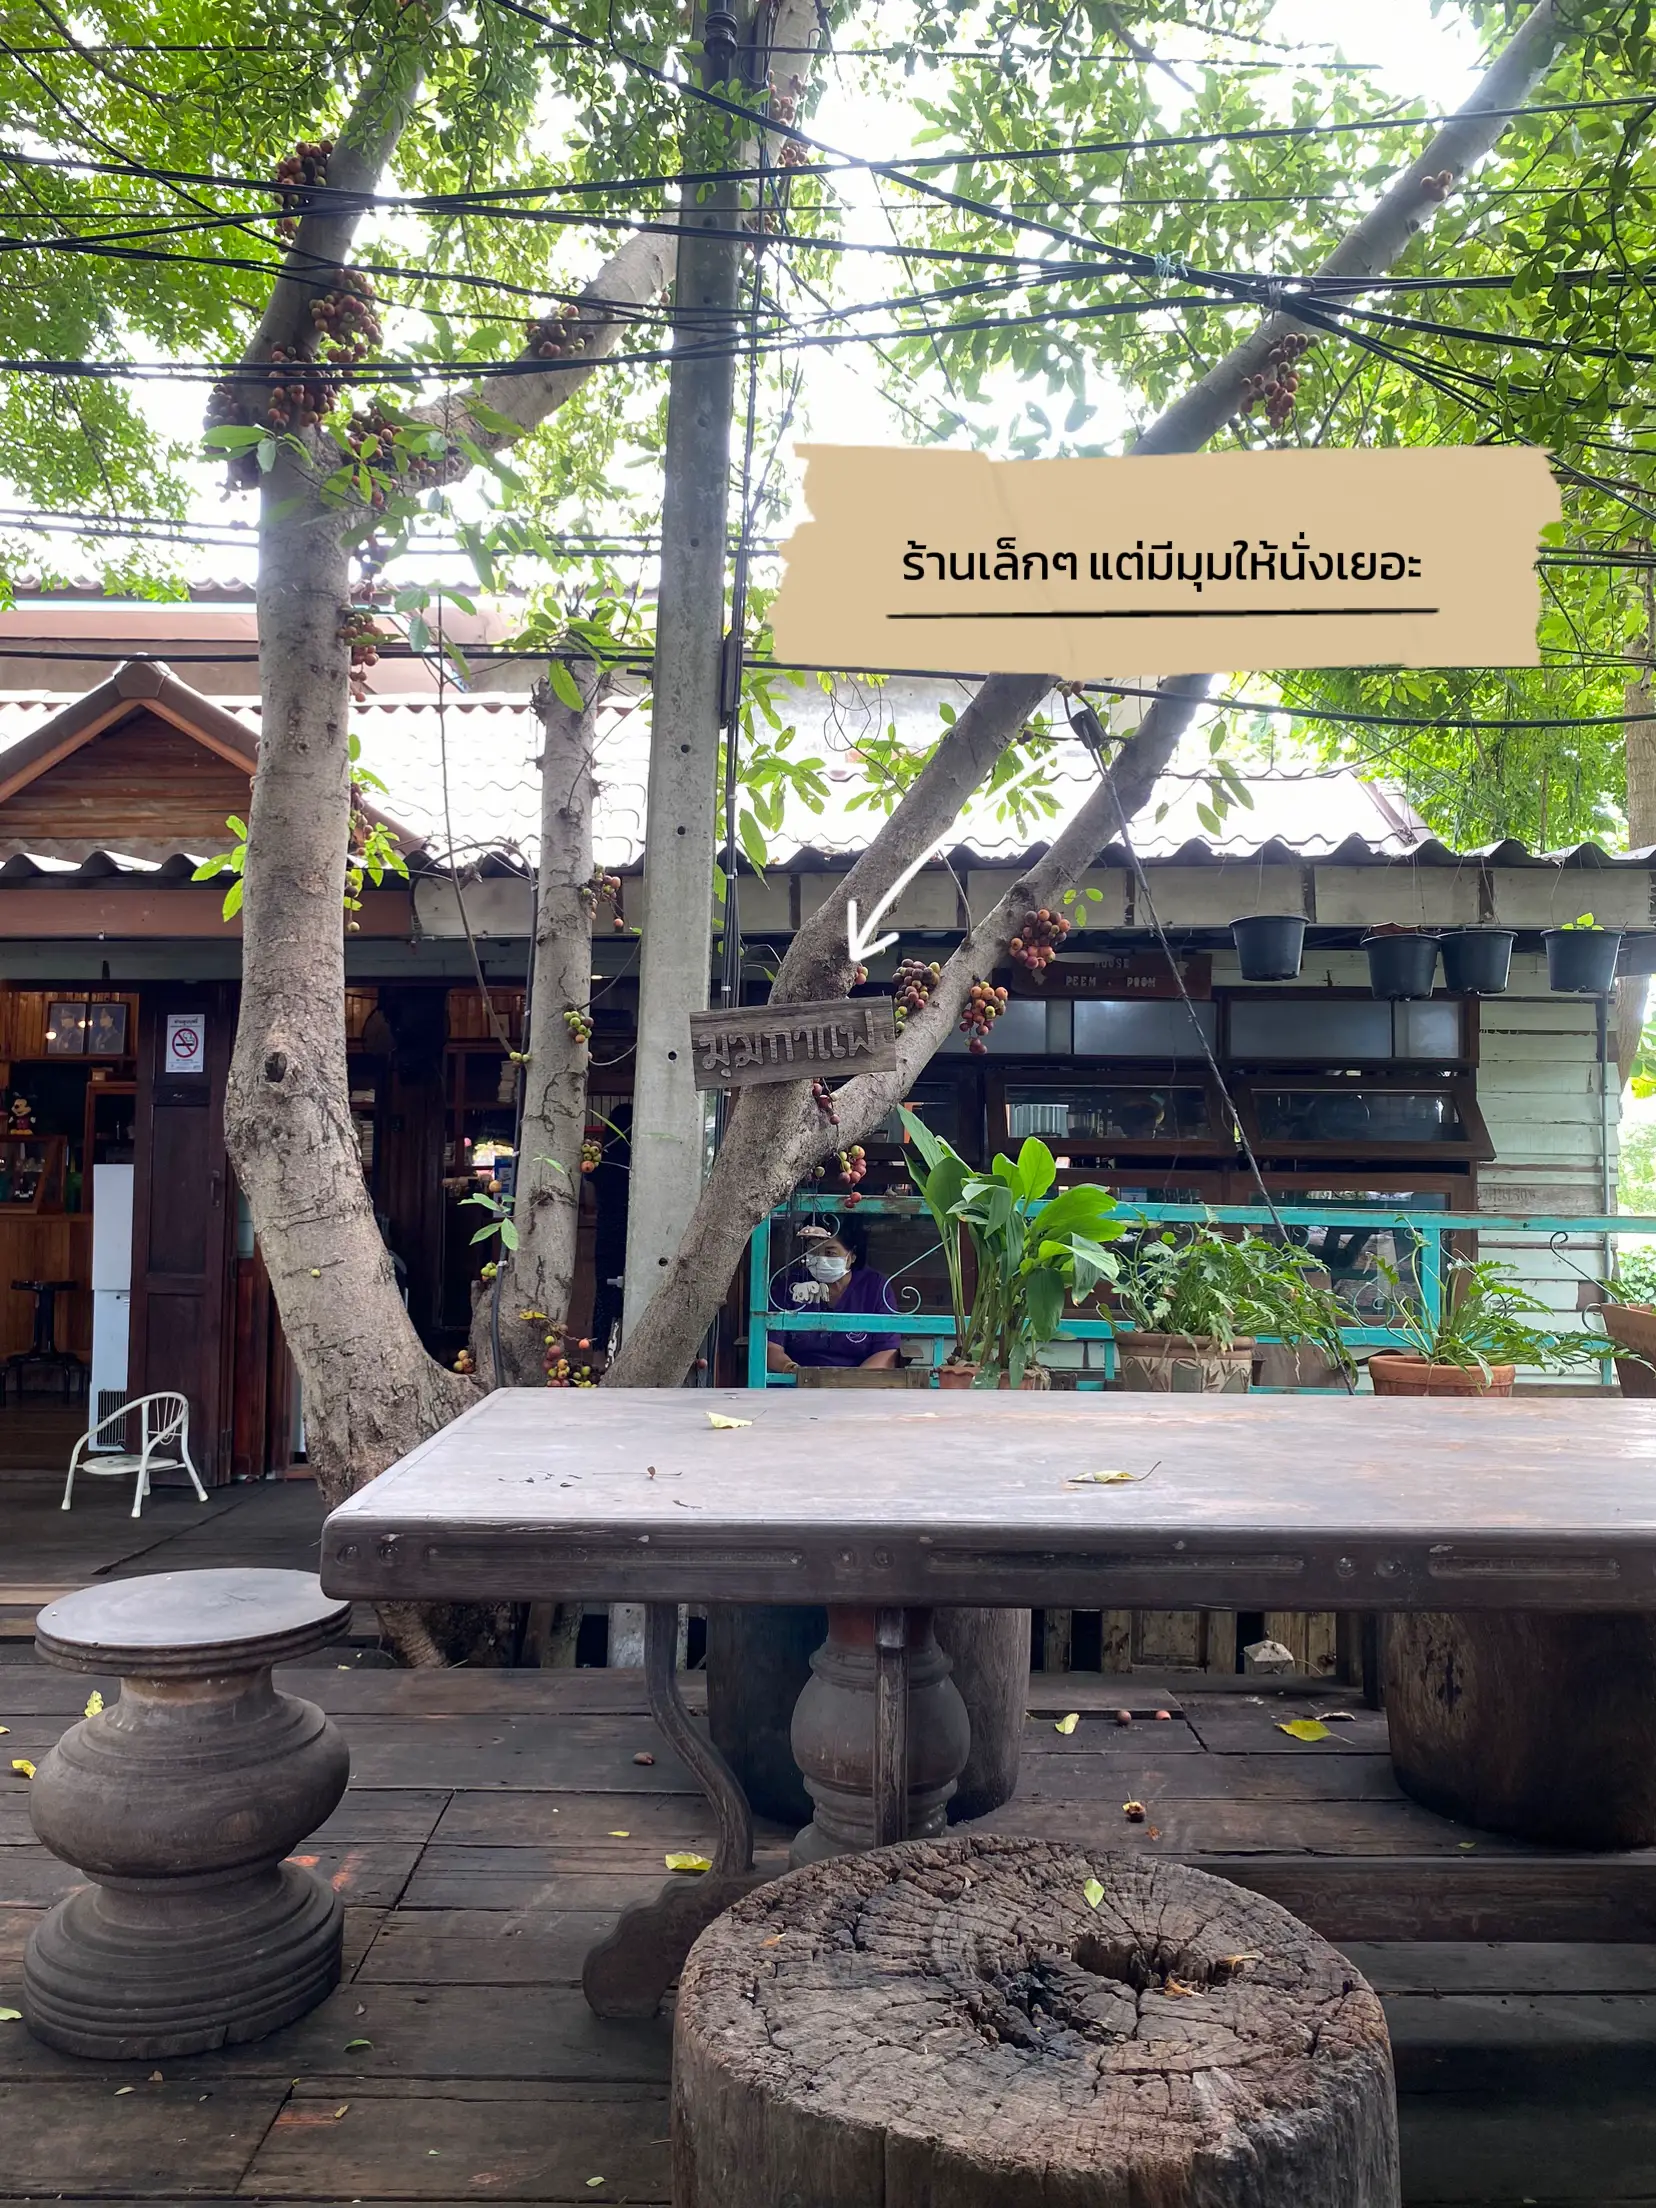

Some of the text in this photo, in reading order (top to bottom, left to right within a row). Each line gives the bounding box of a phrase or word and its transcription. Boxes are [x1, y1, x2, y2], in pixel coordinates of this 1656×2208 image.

[1065, 976, 1097, 988] PEEM
[698, 1008, 876, 1078] มุมกาแฟ
